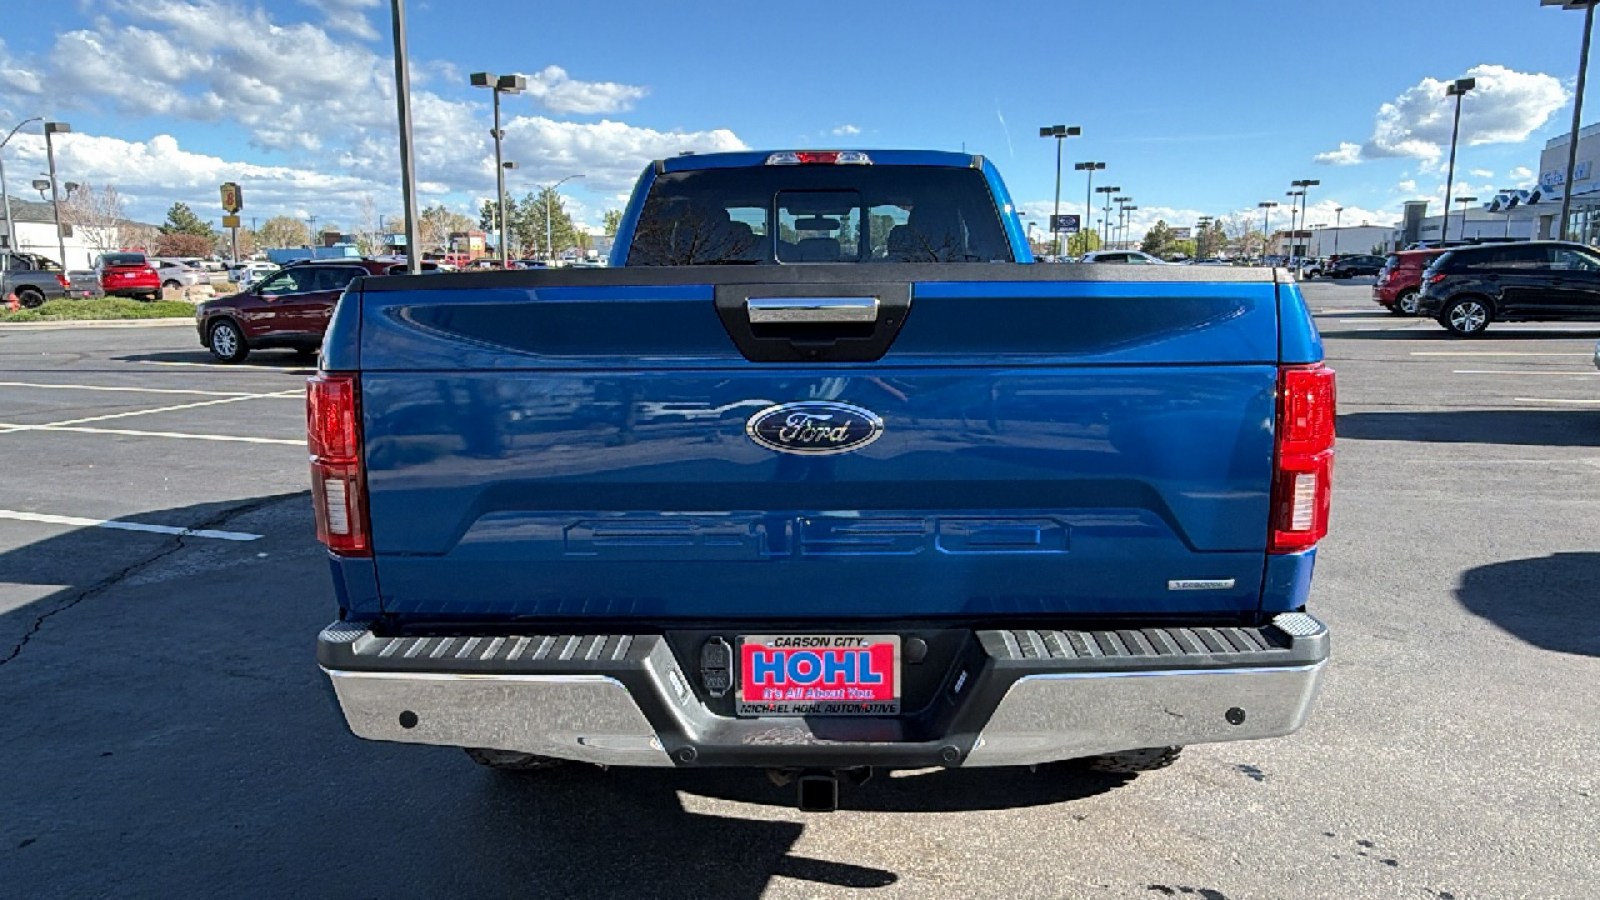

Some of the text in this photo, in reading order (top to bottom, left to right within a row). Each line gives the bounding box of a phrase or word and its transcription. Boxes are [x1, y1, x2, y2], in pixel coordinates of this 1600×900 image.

[779, 413, 852, 442] Ford
[775, 636, 864, 648] CARSON CITY
[753, 651, 883, 684] HOHL
[763, 687, 782, 699] It's
[785, 687, 803, 700] All
[804, 687, 844, 700] About
[740, 703, 897, 714] MICHAEL HOHL AUTOMOTIVE
